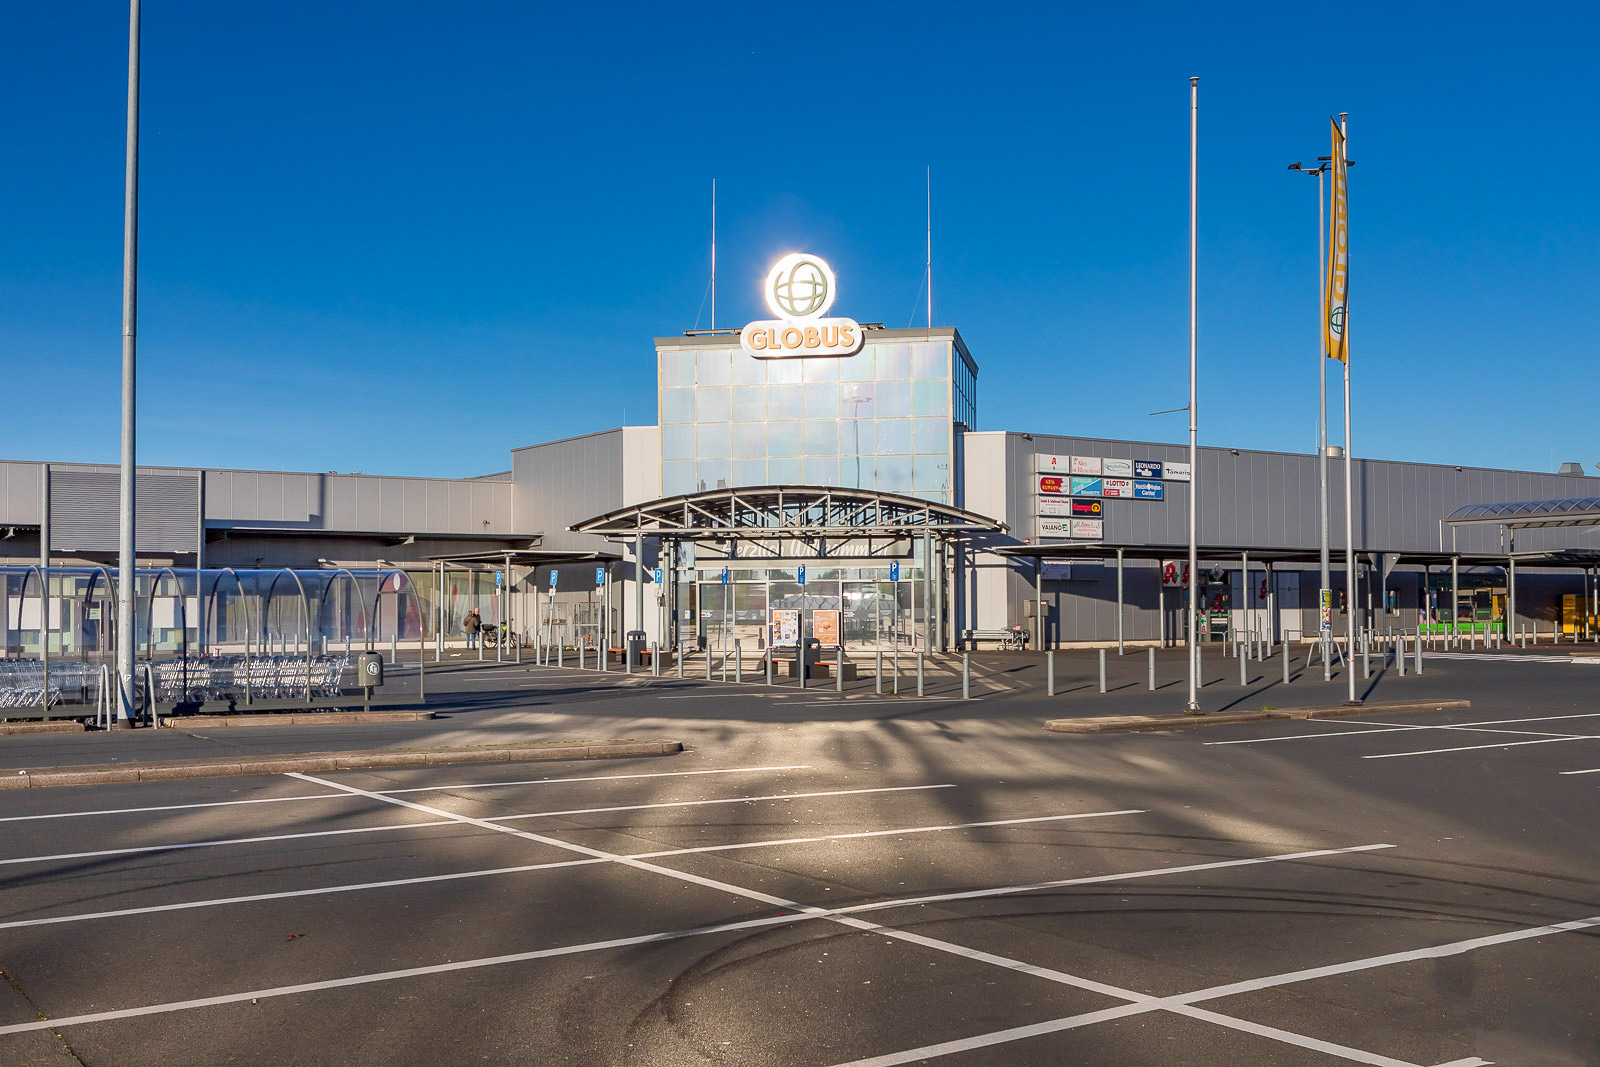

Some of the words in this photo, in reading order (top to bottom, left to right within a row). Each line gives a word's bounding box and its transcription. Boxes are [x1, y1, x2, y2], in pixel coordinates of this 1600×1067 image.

[747, 325, 855, 350] GLOBUS
[1135, 462, 1161, 470] LEONARDO
[891, 563, 897, 571] P
[597, 570, 603, 581] P
[656, 571, 661, 581] P
[722, 568, 727, 576] P
[497, 573, 501, 581] P
[551, 573, 556, 583] P
